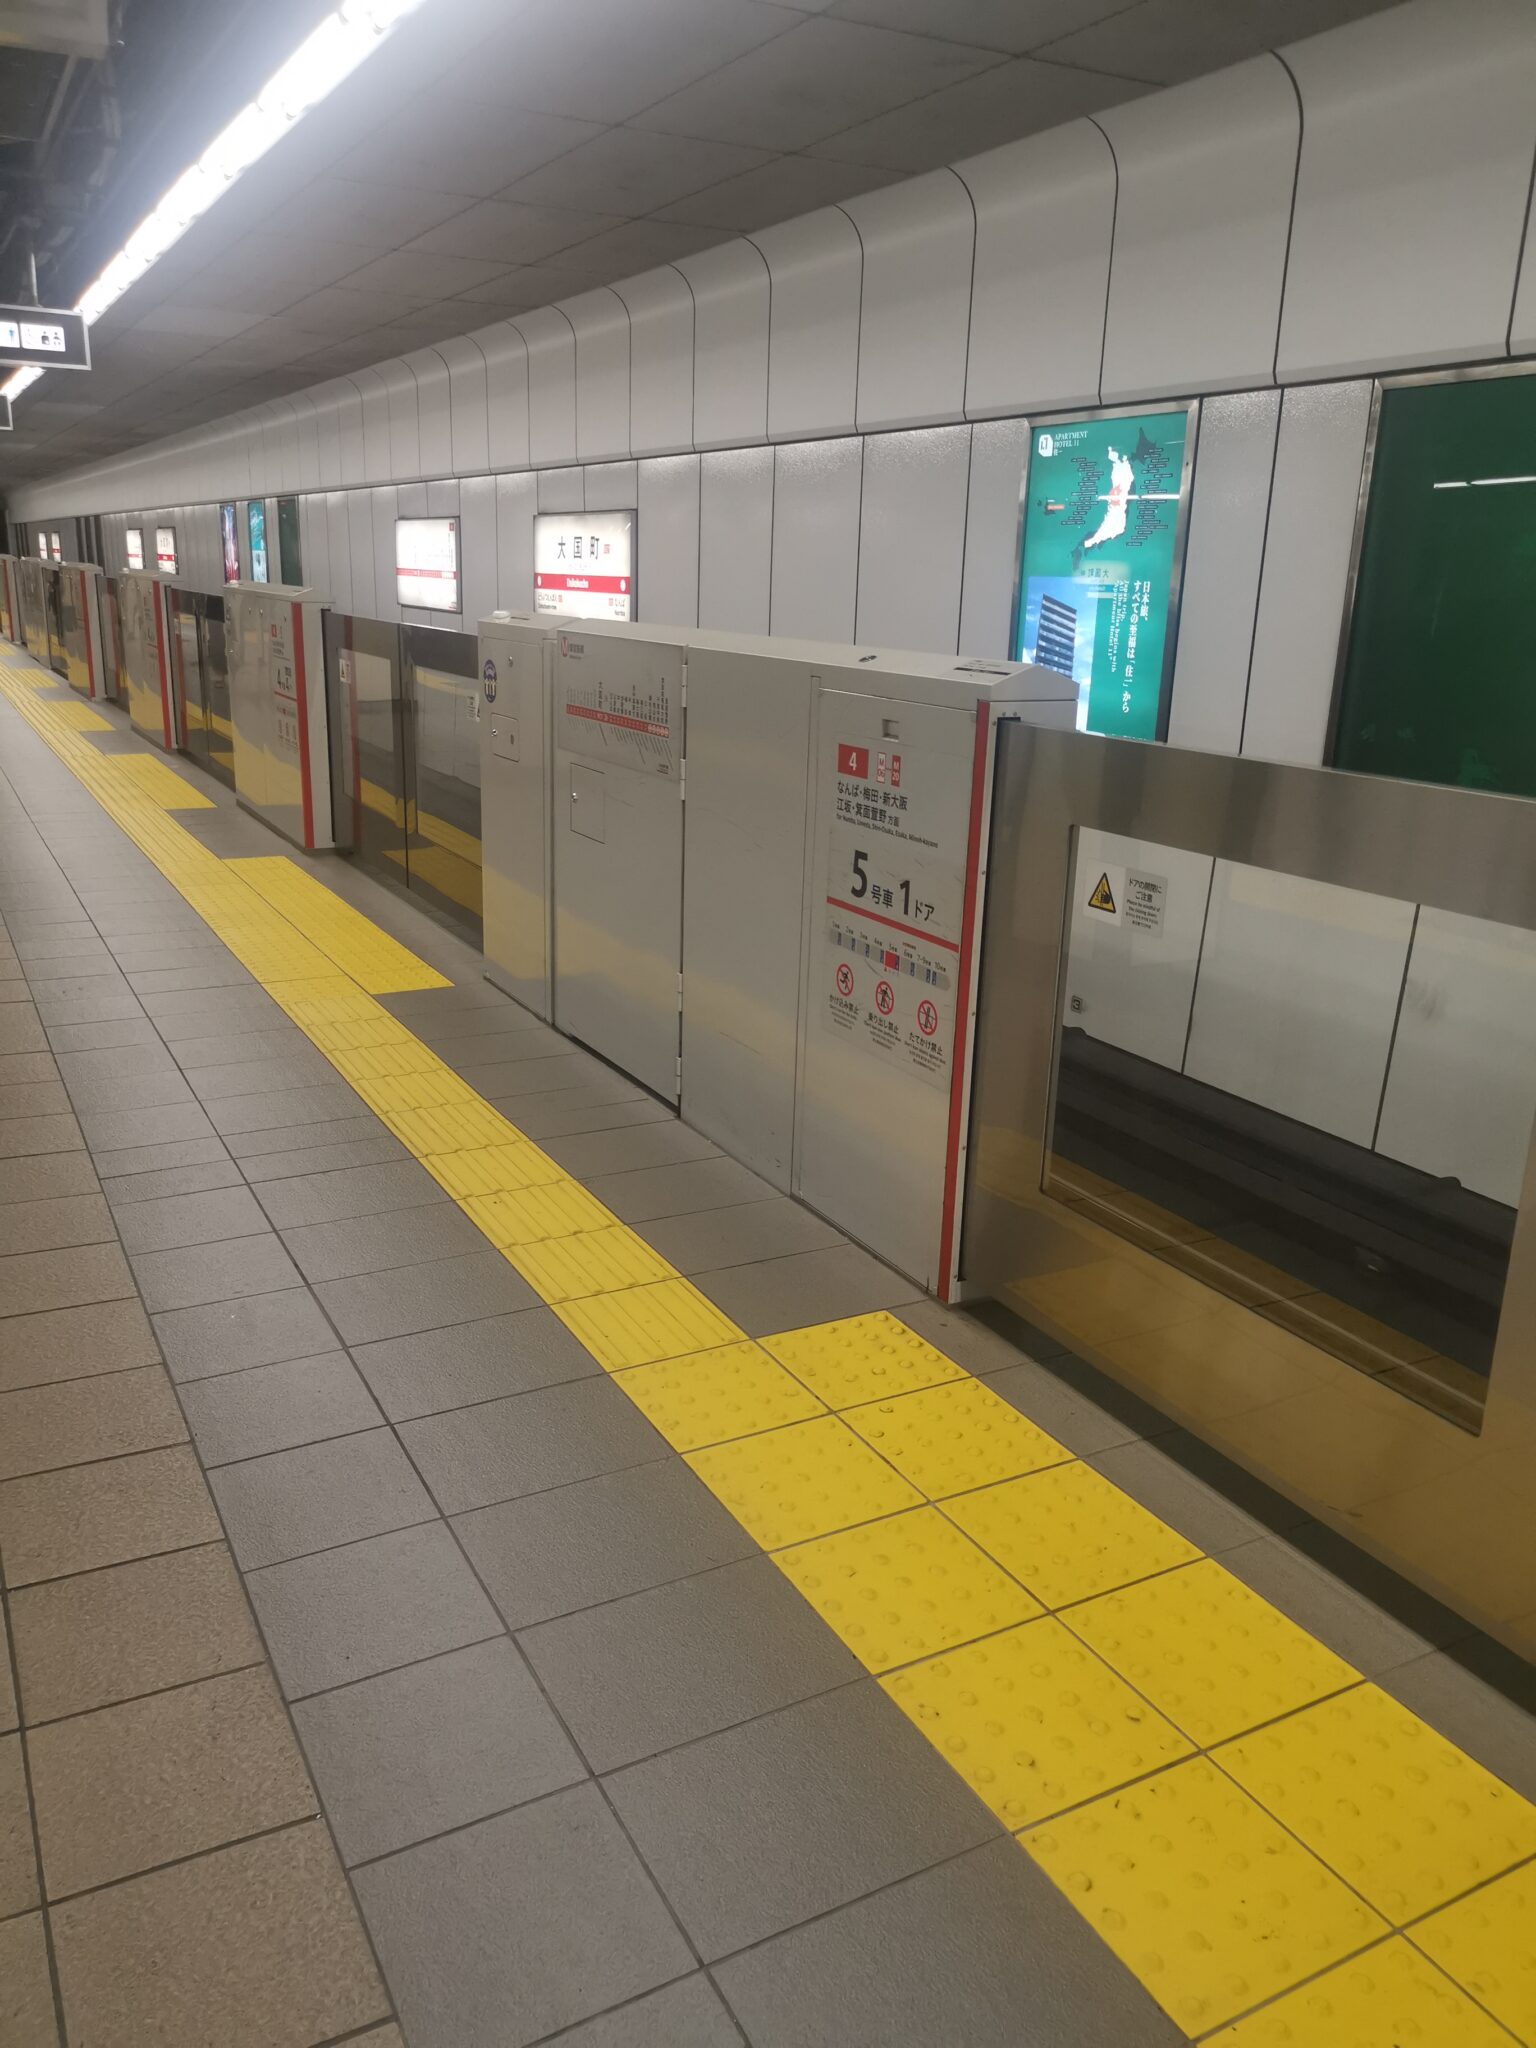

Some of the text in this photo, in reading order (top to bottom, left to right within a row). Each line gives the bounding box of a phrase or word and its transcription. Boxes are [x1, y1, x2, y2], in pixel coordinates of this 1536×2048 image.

[1054, 440, 1073, 448] HOTEL
[1055, 431, 1088, 441] APARTMENT
[557, 536, 600, 560] 大国町
[849, 752, 857, 771] 4
[837, 781, 908, 811] なんば・梅田・新大阪
